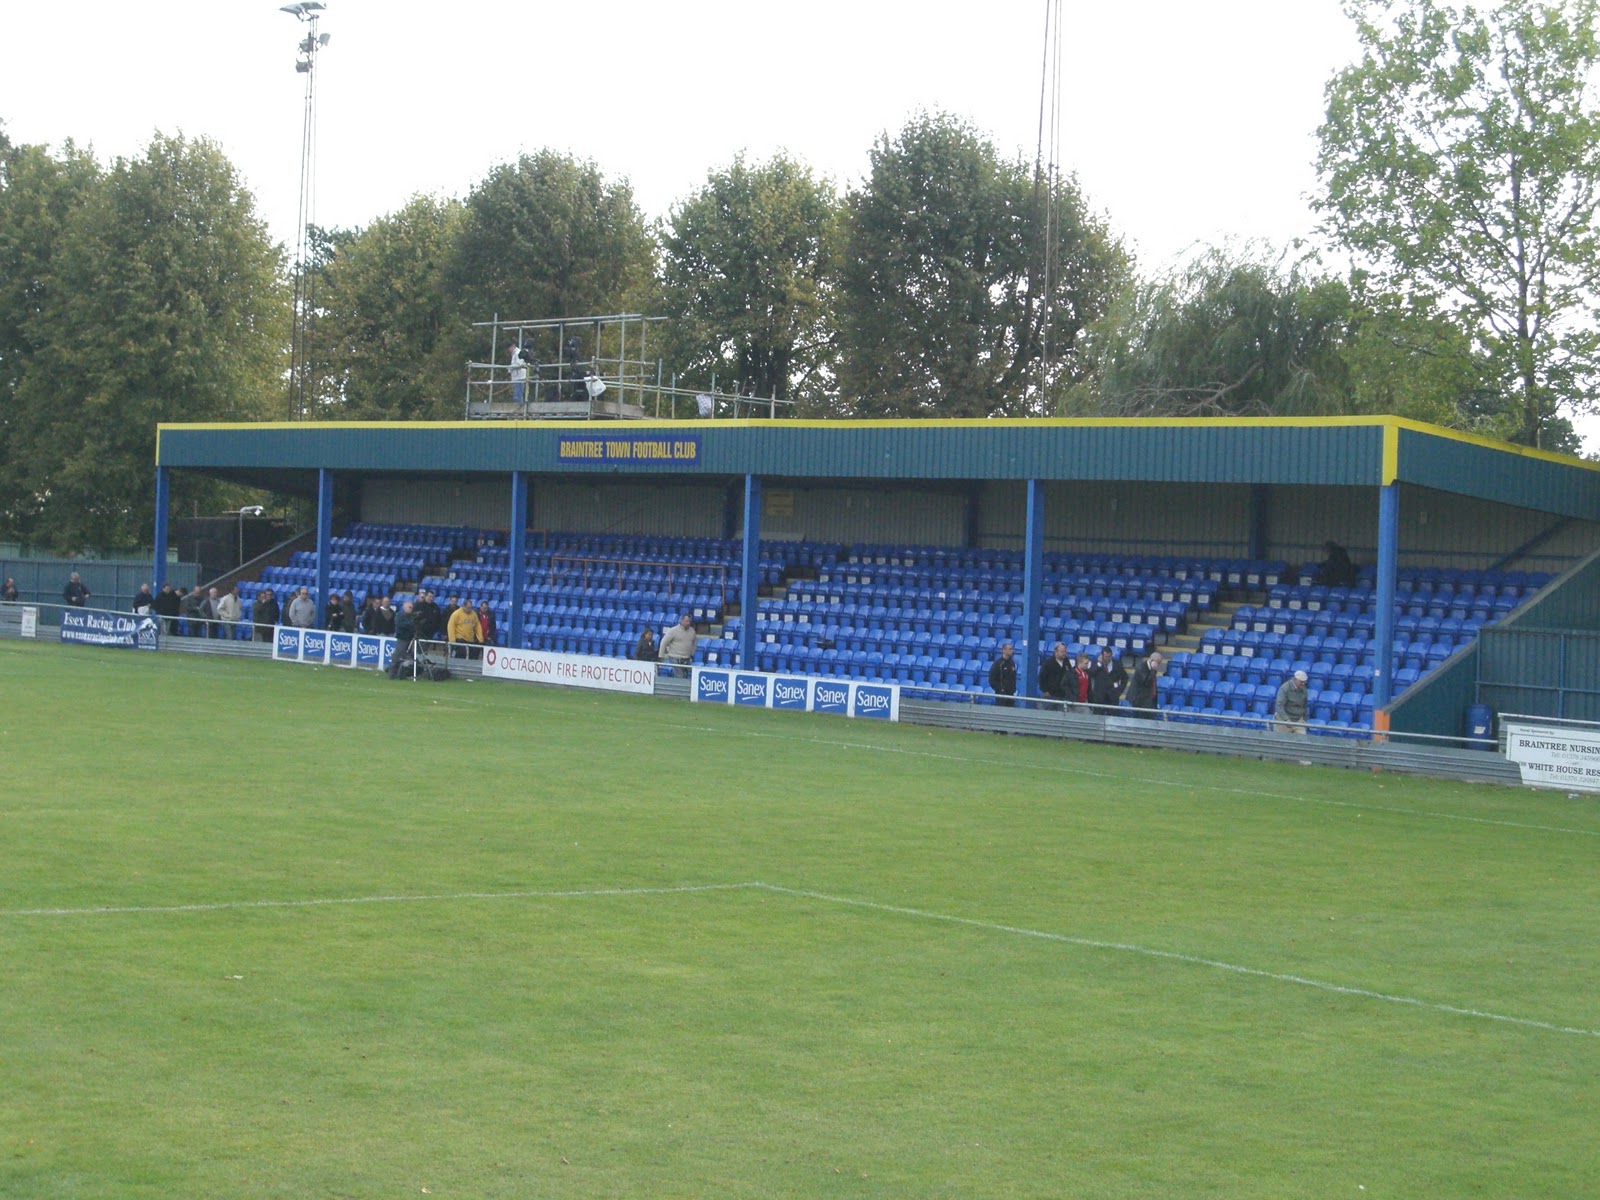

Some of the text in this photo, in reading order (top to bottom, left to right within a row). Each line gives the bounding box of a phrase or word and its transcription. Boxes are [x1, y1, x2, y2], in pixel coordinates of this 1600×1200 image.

[560, 441, 697, 459] BRAINTREE TOWN FOOTBALL CLUB
[64, 612, 137, 632] Essex Racing Club
[279, 632, 298, 647] Sanex
[304, 635, 325, 650] Sanex
[331, 638, 352, 653] Sanex
[357, 641, 379, 656] Sanex
[500, 656, 652, 686] OCTAGON FIRE PROTECTION
[700, 676, 727, 693] Sanex
[736, 679, 765, 697] Sanex
[775, 683, 805, 700] Sanex
[816, 686, 847, 705] Sanex
[857, 690, 889, 709] Sanex
[1519, 739, 1567, 751] BRAINTREE
[1528, 762, 1554, 772] WHITE
[1556, 765, 1584, 775] HOUSE
